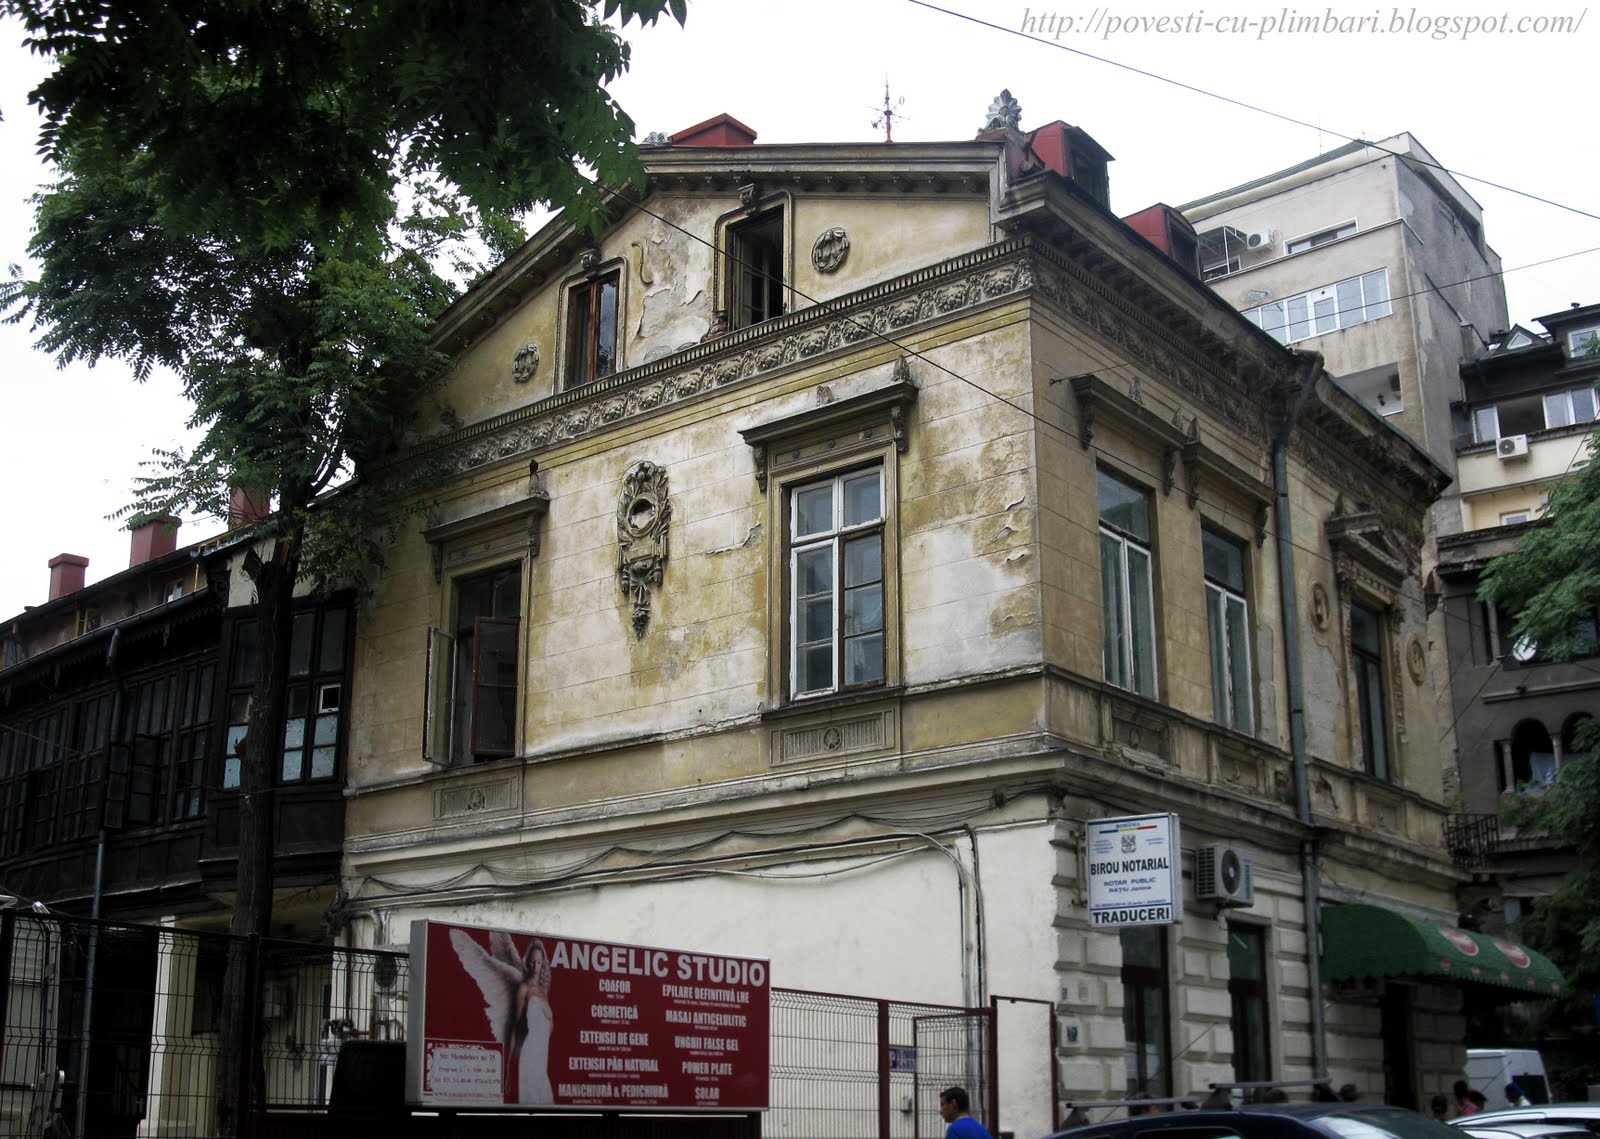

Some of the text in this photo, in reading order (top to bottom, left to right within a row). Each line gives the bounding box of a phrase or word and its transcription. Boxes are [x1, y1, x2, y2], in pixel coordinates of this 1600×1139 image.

[1090, 857, 1169, 876] BIROU NOTARIAL
[1130, 877, 1156, 885] PUBLIC
[1093, 907, 1170, 924] TRADUCERI
[550, 941, 765, 987] ANGELIC STUDIO
[599, 978, 631, 994] COAFOR
[662, 984, 694, 999] EPILARE
[665, 1009, 692, 1023] MASAJ
[693, 1012, 747, 1028] ANTICELULITIC
[580, 1030, 649, 1046] EXTENSII DE GENE
[674, 1035, 739, 1052] UNGHII FALSE GEL
[568, 1056, 606, 1071] EXTENSII
[624, 1058, 660, 1072] NATURAL
[682, 1061, 733, 1076] POWER PLATE
[613, 1086, 620, 1098] &
[695, 1087, 720, 1100] SOLAR
